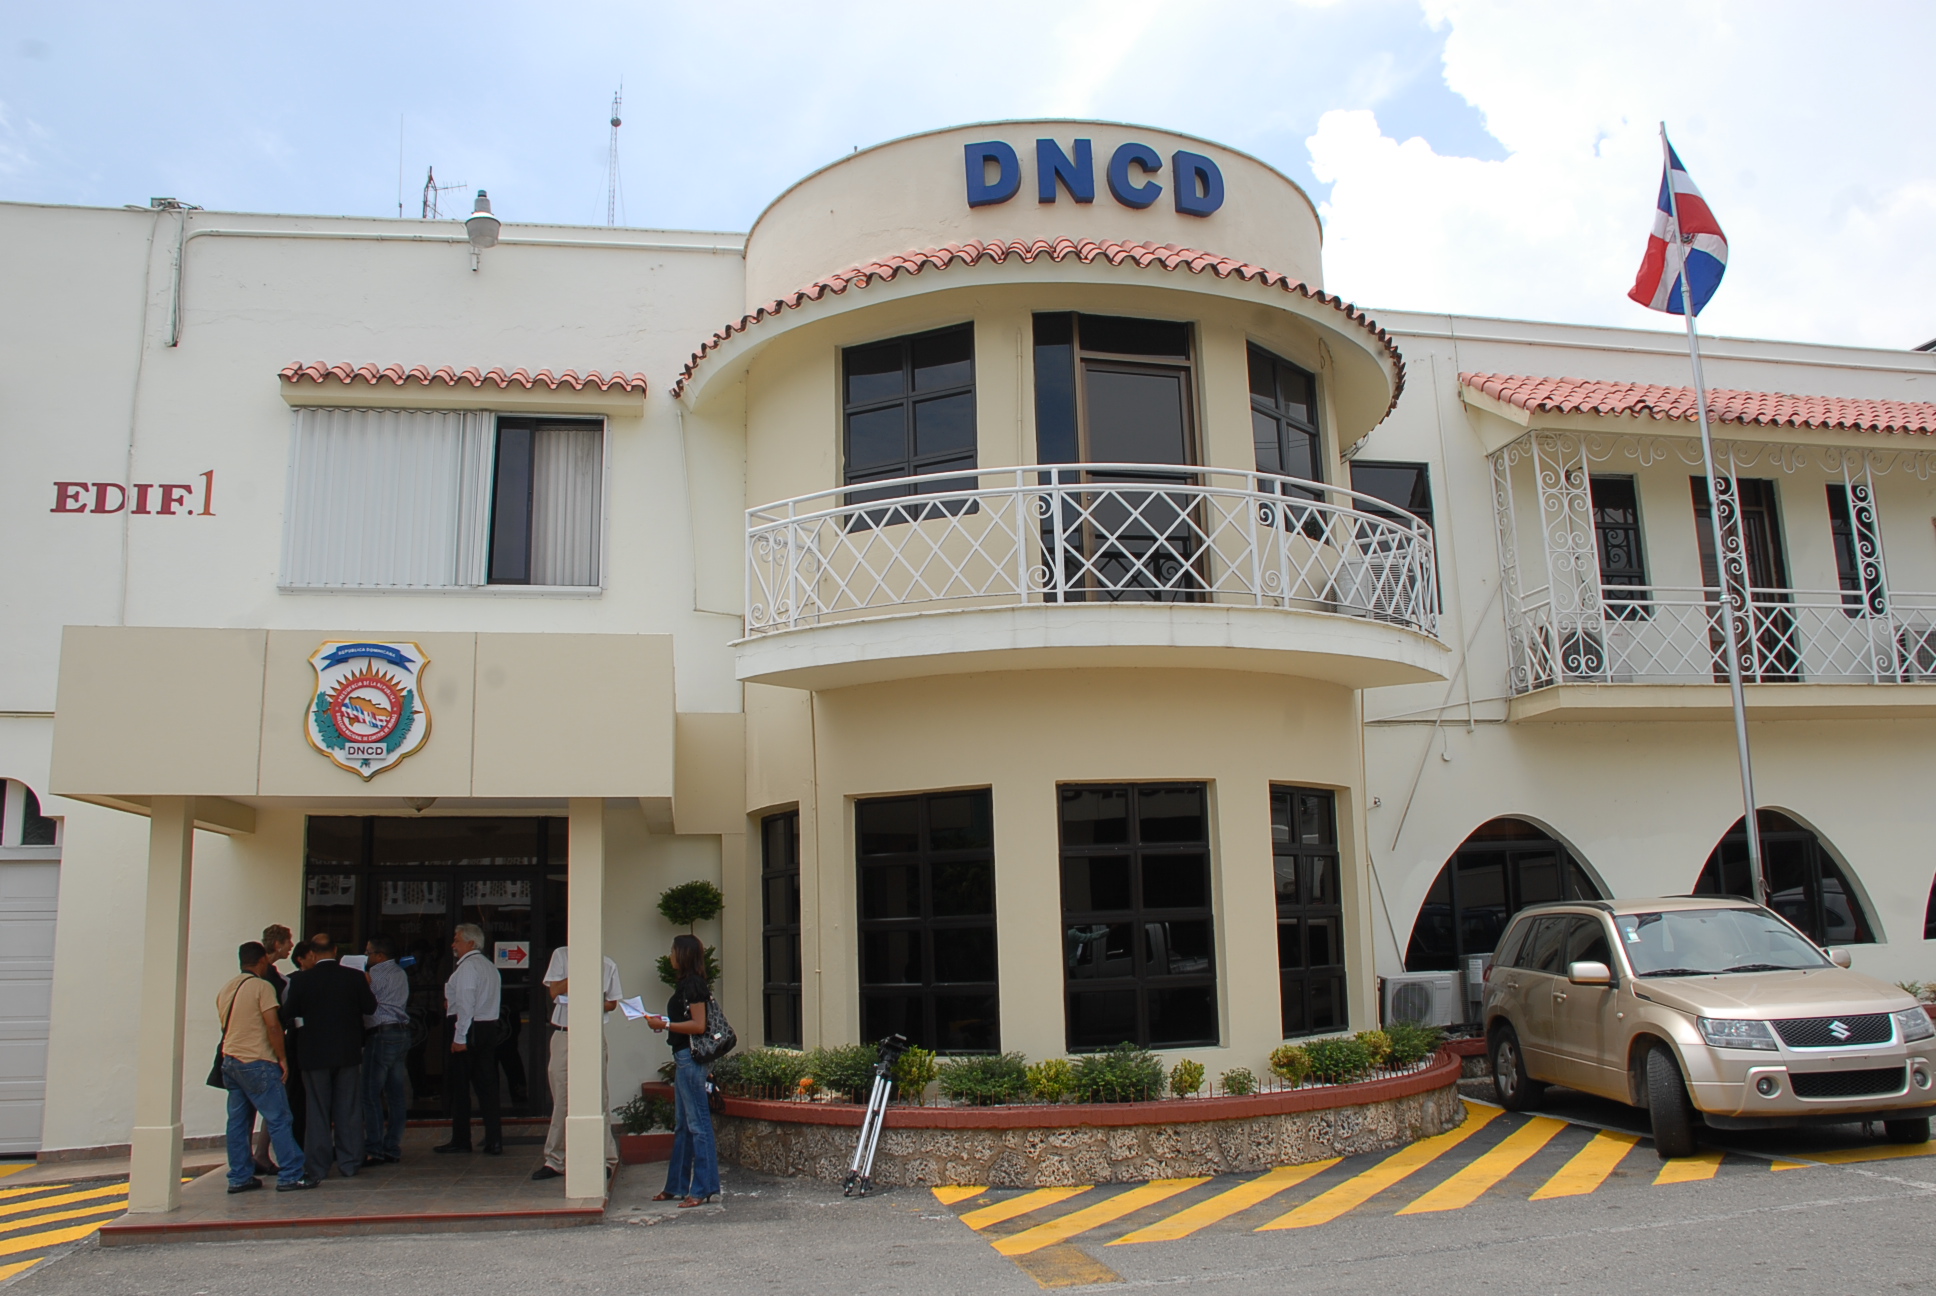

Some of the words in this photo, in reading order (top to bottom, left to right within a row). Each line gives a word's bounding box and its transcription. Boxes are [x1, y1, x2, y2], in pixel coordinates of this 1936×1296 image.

[964, 139, 1225, 218] DNCD
[338, 647, 365, 656] REPUBLICA
[366, 648, 396, 657] DOMINICANA
[337, 681, 363, 702] PRESIDENCIA
[377, 683, 396, 702] REPUBLICA
[345, 729, 362, 741] NACIONAL
[368, 730, 385, 741] CONTROL
[388, 714, 398, 729] DROGAS
[347, 746, 384, 755] DNCD
